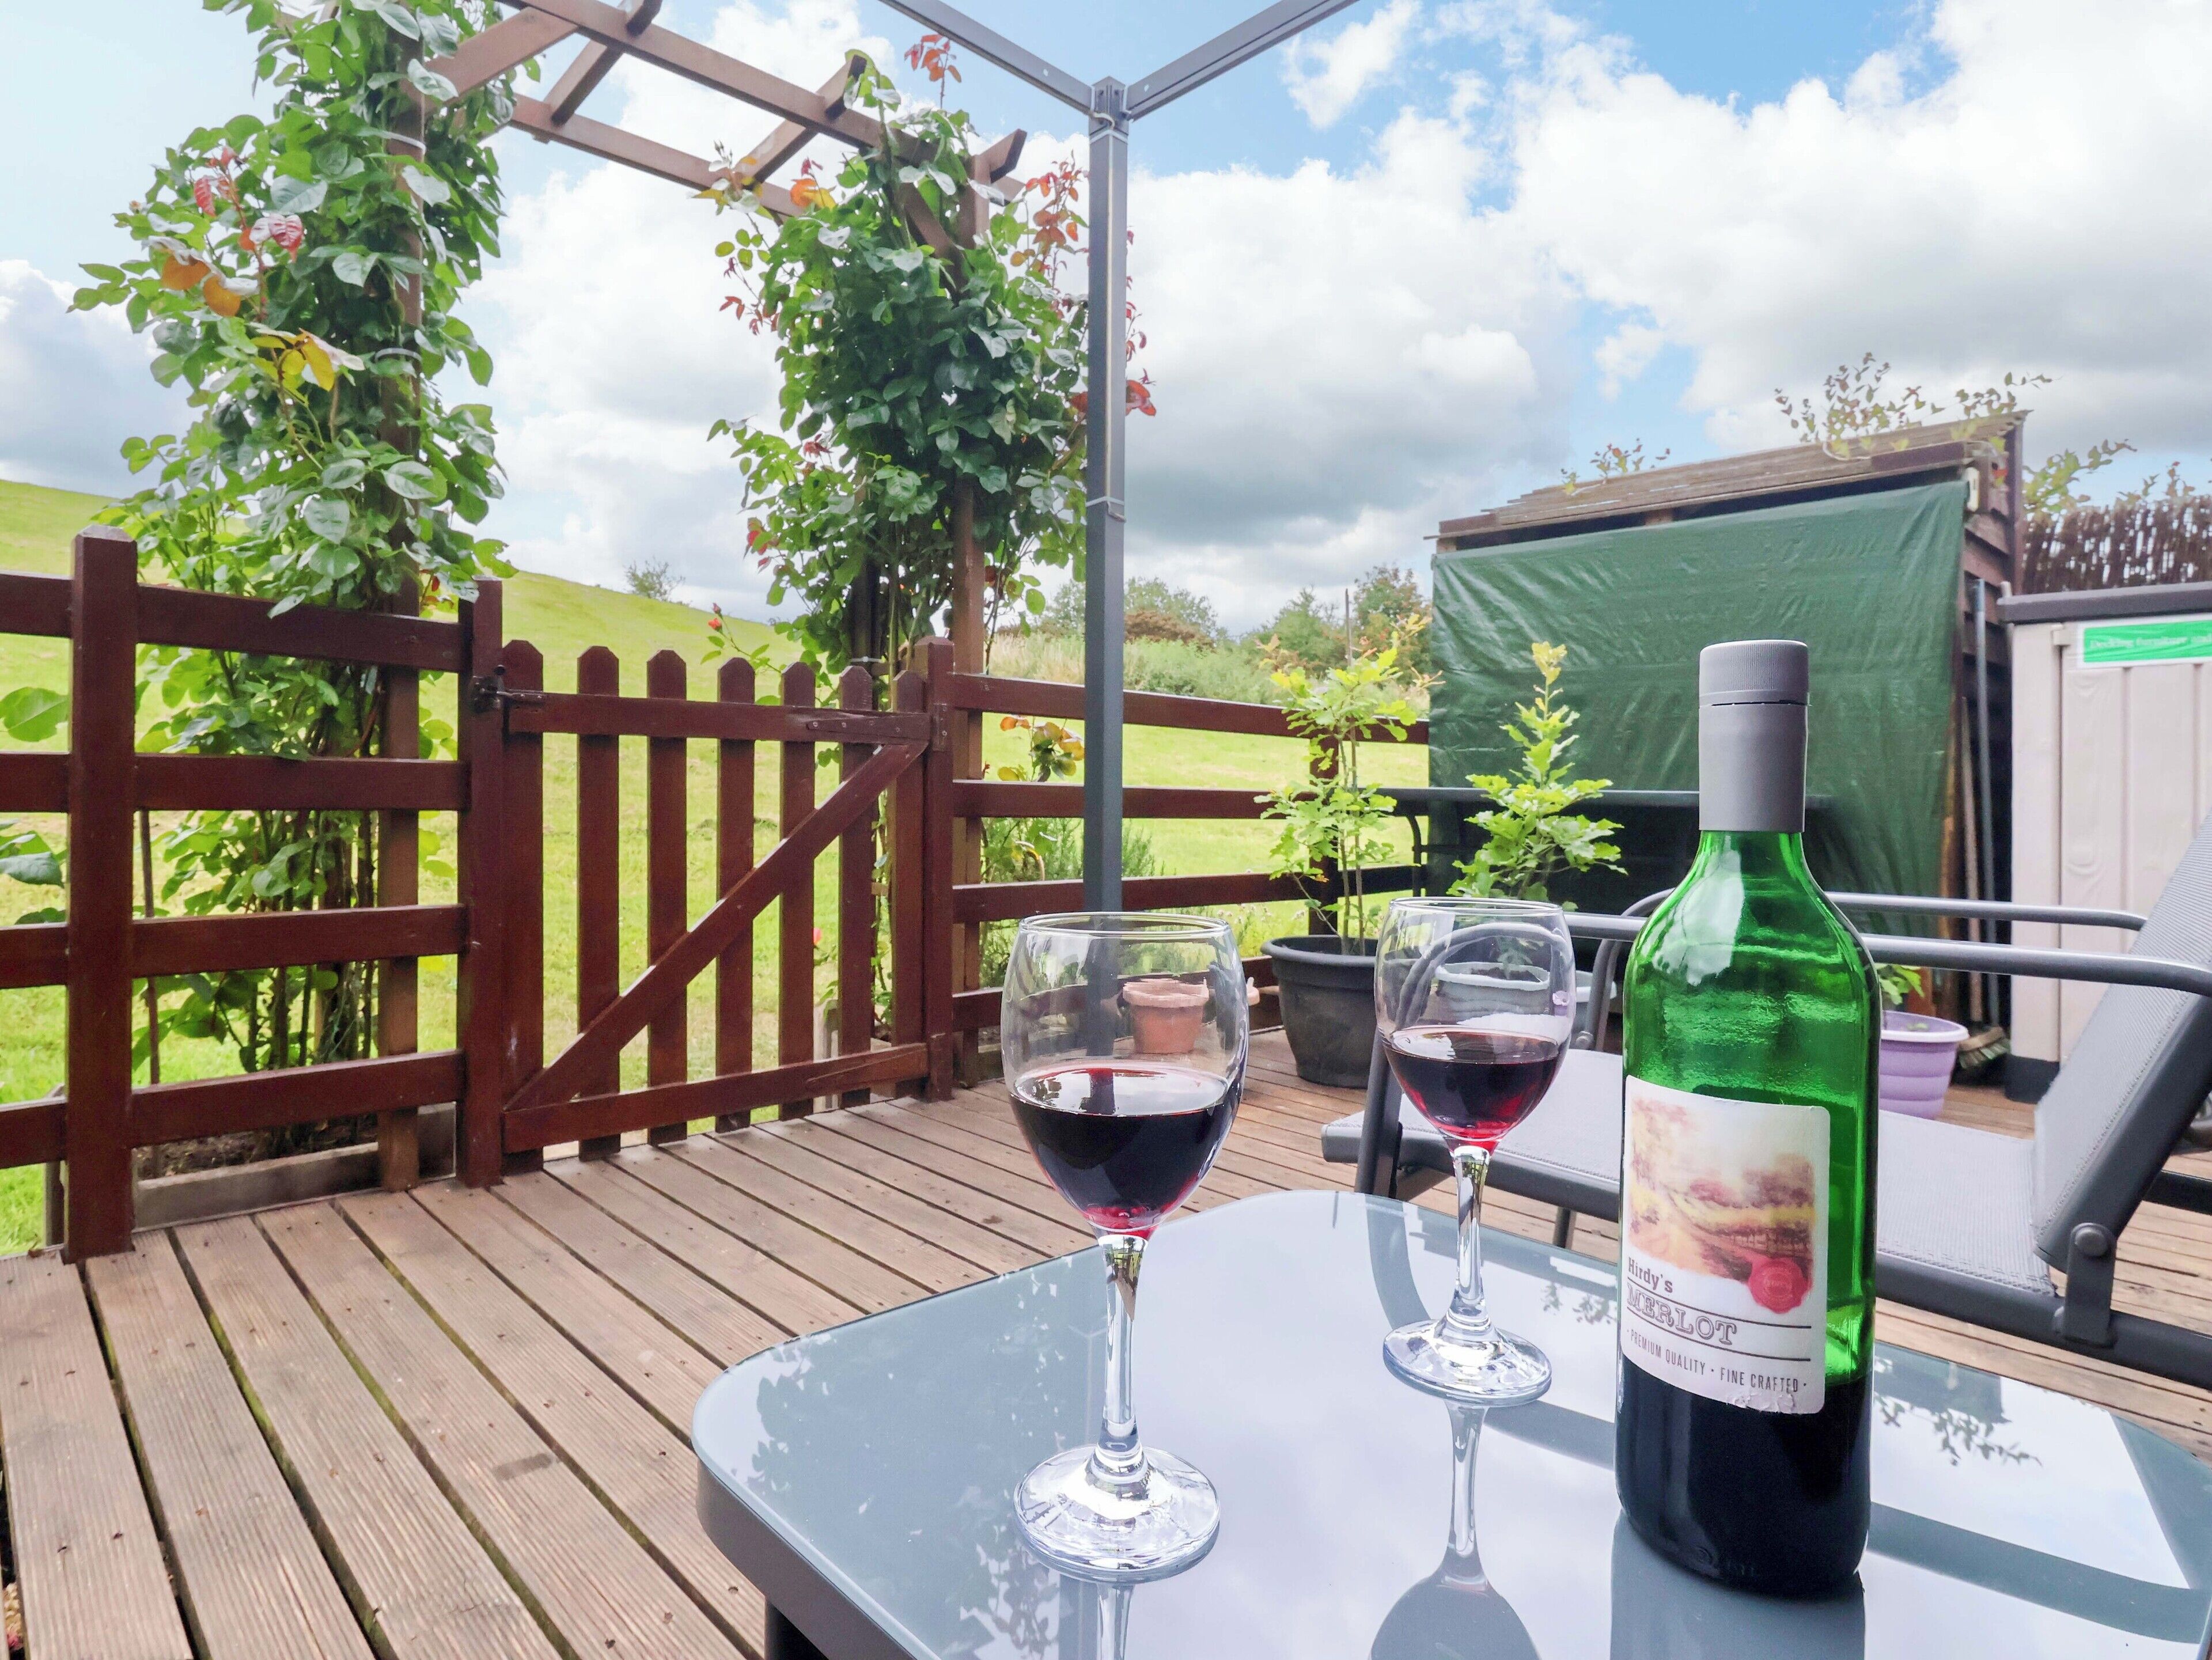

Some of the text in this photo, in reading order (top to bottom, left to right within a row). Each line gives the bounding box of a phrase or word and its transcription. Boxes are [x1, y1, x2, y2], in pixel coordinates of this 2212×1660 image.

[1627, 1256, 1673, 1293] Hirdy's
[1627, 1282, 1737, 1346] MERLOT
[1630, 1329, 1798, 1393] PREMIUM QUALITY FINE CRAFTED
